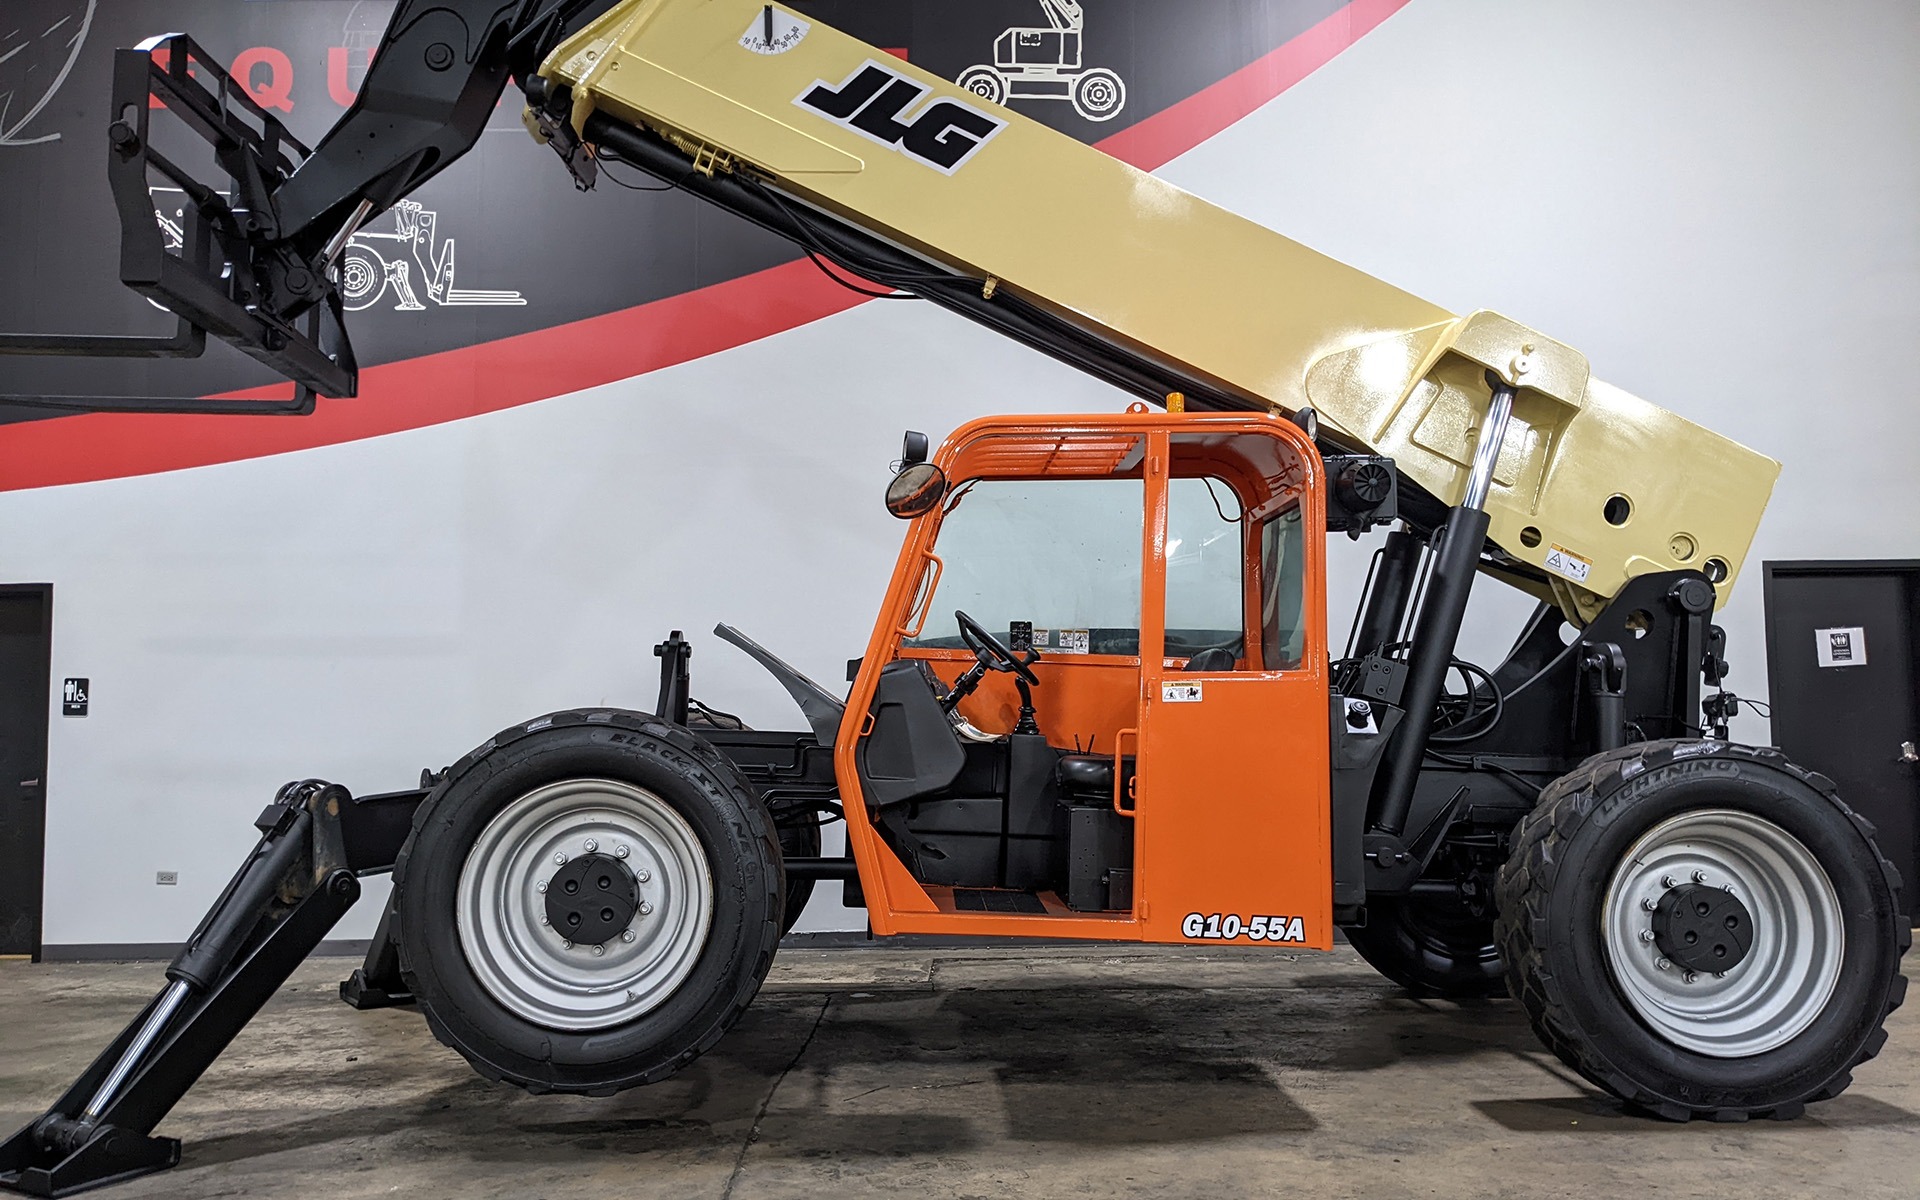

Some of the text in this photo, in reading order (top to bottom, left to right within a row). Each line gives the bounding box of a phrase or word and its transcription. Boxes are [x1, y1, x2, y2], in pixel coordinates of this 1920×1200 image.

[798, 62, 1002, 172] JLG
[1603, 761, 1732, 814] LIGHTNING
[1183, 912, 1306, 942] G10-55A
